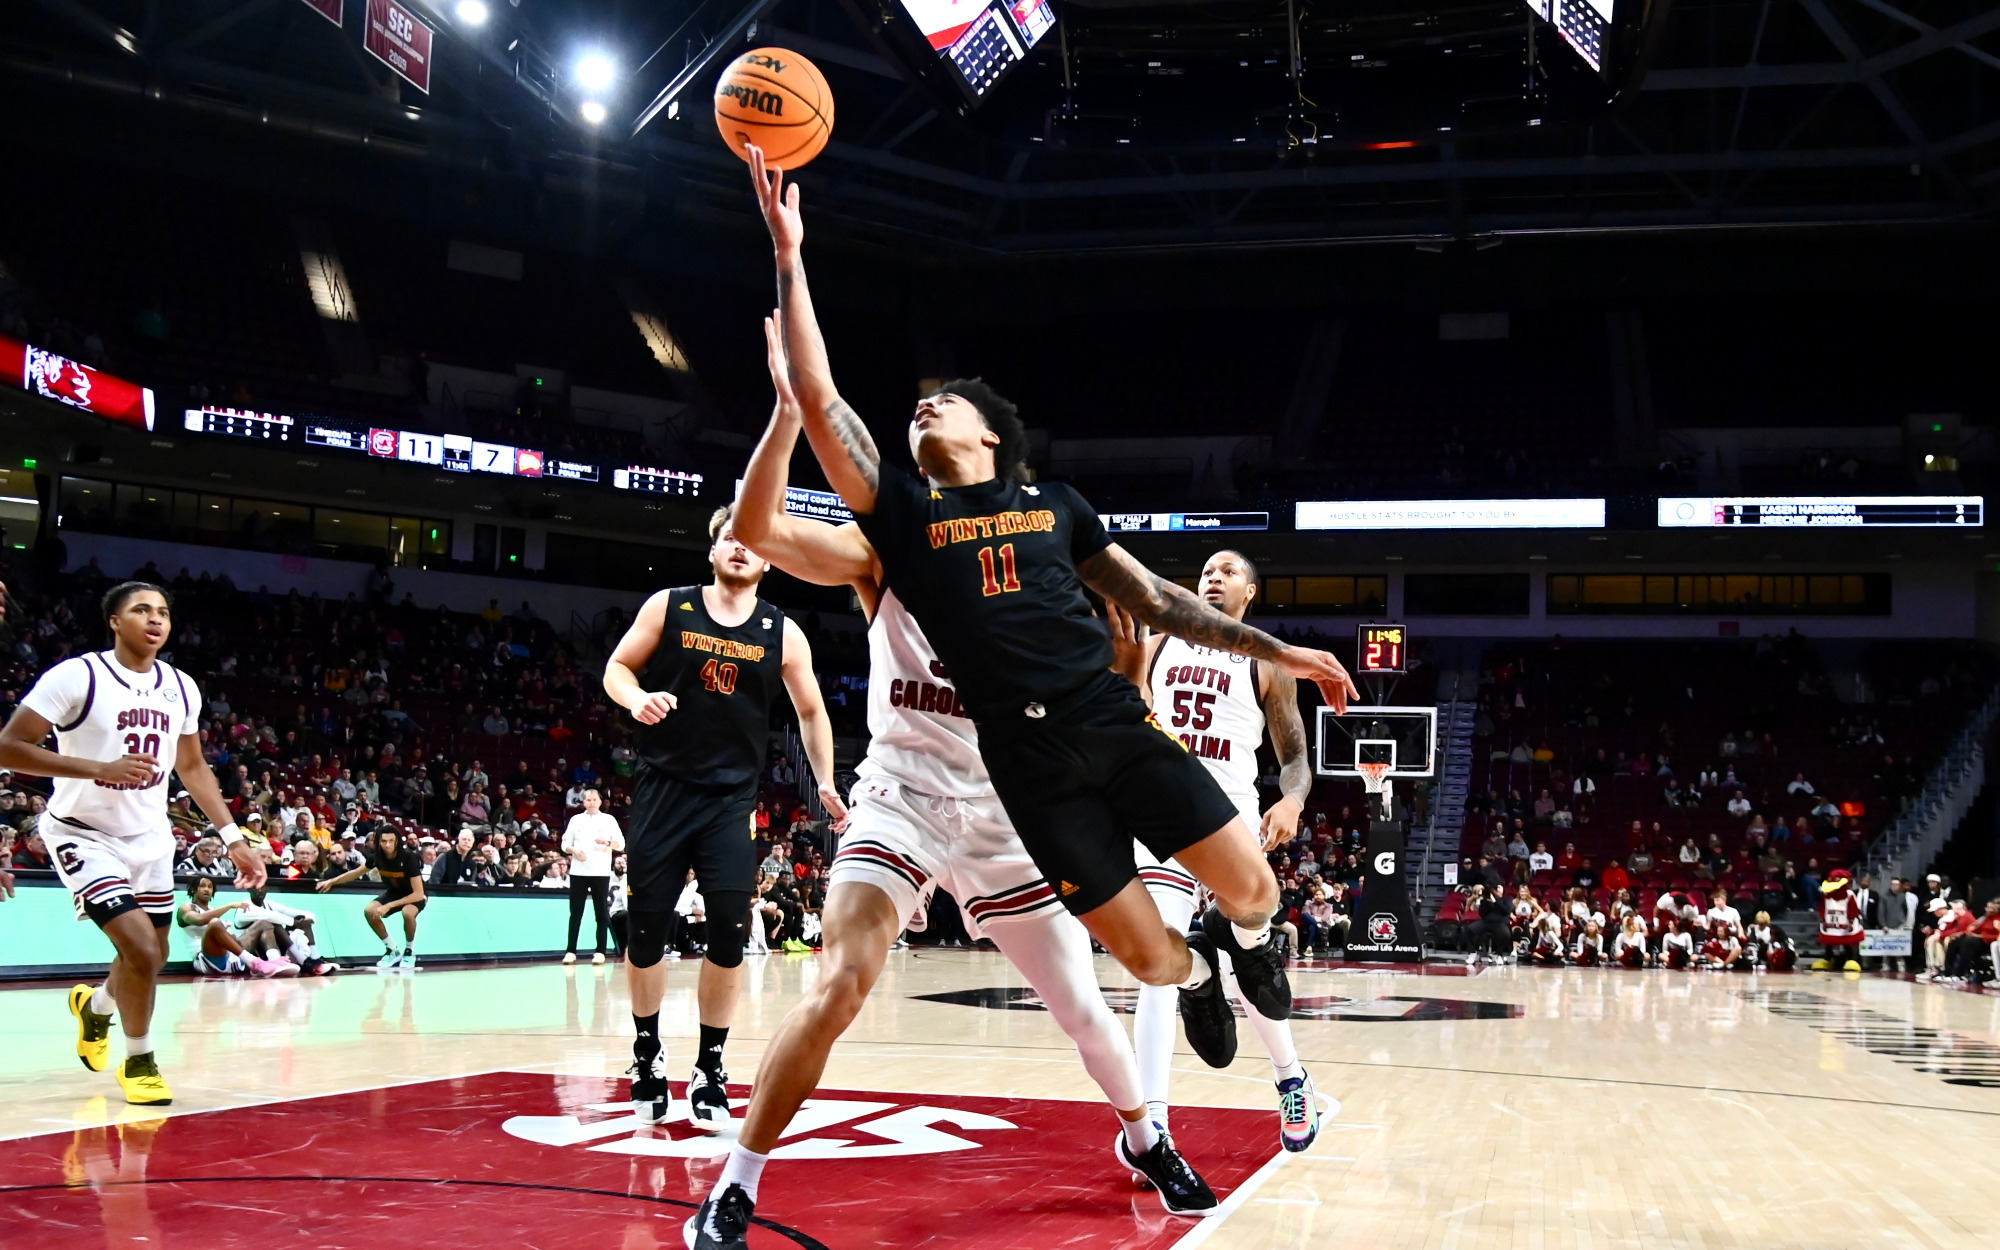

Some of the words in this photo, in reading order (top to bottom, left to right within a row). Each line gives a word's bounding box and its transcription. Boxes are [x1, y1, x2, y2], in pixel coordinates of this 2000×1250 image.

[388, 7, 412, 42] SEC
[408, 438, 432, 458] 11
[487, 450, 500, 466] 7
[786, 490, 808, 502] Head
[810, 493, 836, 506] coach
[786, 500, 806, 512] 33rd
[807, 504, 829, 515] head
[1127, 515, 1149, 523] HALF
[1185, 518, 1220, 528] Memphis
[1372, 512, 1404, 520] STATS
[1407, 512, 1458, 520] BROUGHT
[1478, 511, 1501, 519] YOU
[926, 510, 1056, 549] WINTHROP
[978, 543, 1022, 597] 11
[681, 630, 765, 662] WINTHROP
[1368, 630, 1402, 643] 11:46
[1366, 644, 1398, 668] 21
[700, 658, 738, 695] 40
[1165, 666, 1232, 696] SOUTH
[890, 678, 966, 718] CAROL
[1171, 690, 1216, 730] 55
[116, 708, 170, 734] SOUTH
[1179, 733, 1230, 762] OLINA
[1374, 852, 1395, 875] G
[1347, 943, 1379, 951] Colonial
[1380, 944, 1393, 952] Life
[1394, 944, 1418, 952] Arena
